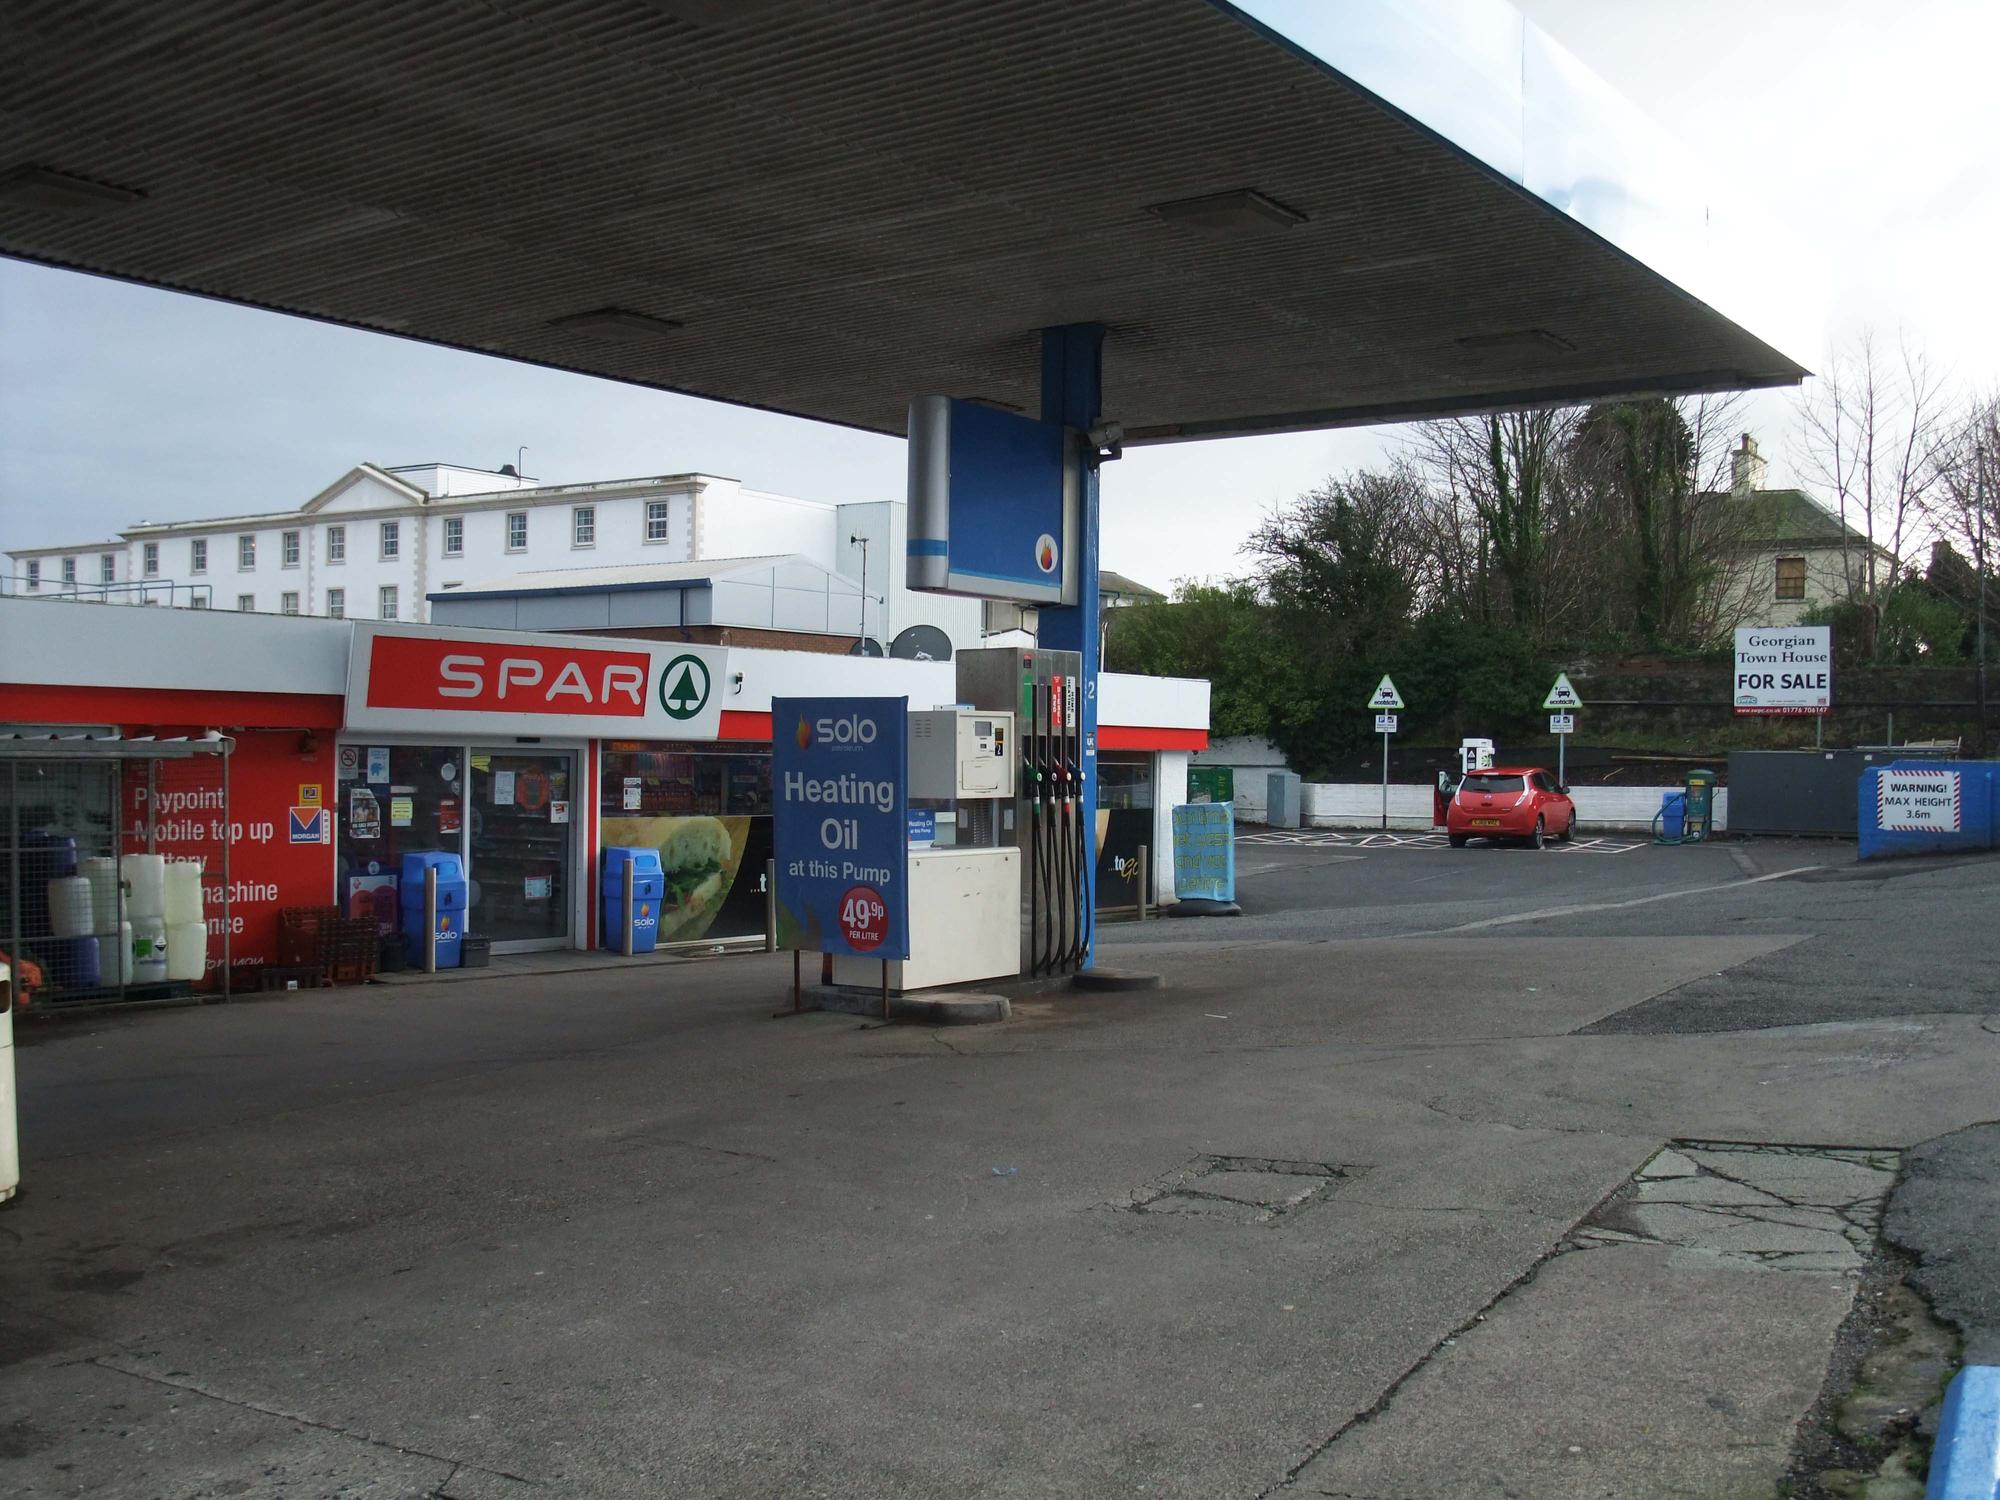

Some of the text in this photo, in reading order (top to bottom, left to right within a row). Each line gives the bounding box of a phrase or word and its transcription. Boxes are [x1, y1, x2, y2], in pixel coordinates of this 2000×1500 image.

[1748, 635, 1816, 650] Georgian
[1737, 651, 1828, 663] Town House
[438, 654, 644, 706] SPAR
[1738, 673, 1827, 690] FOR SALE
[1087, 681, 1095, 699] 2
[816, 713, 877, 743] solo
[784, 771, 894, 813] Heating
[1890, 783, 1948, 794] WARNING!
[1884, 797, 1952, 807] MAX HEIGHT
[1906, 809, 1931, 819] 3.6m
[134, 819, 274, 845] Mobile top up
[820, 818, 858, 851] Oil
[788, 860, 891, 886] at this Pump
[634, 917, 655, 927] solo
[435, 931, 458, 941] solo
[849, 930, 879, 941] PER LITRE
